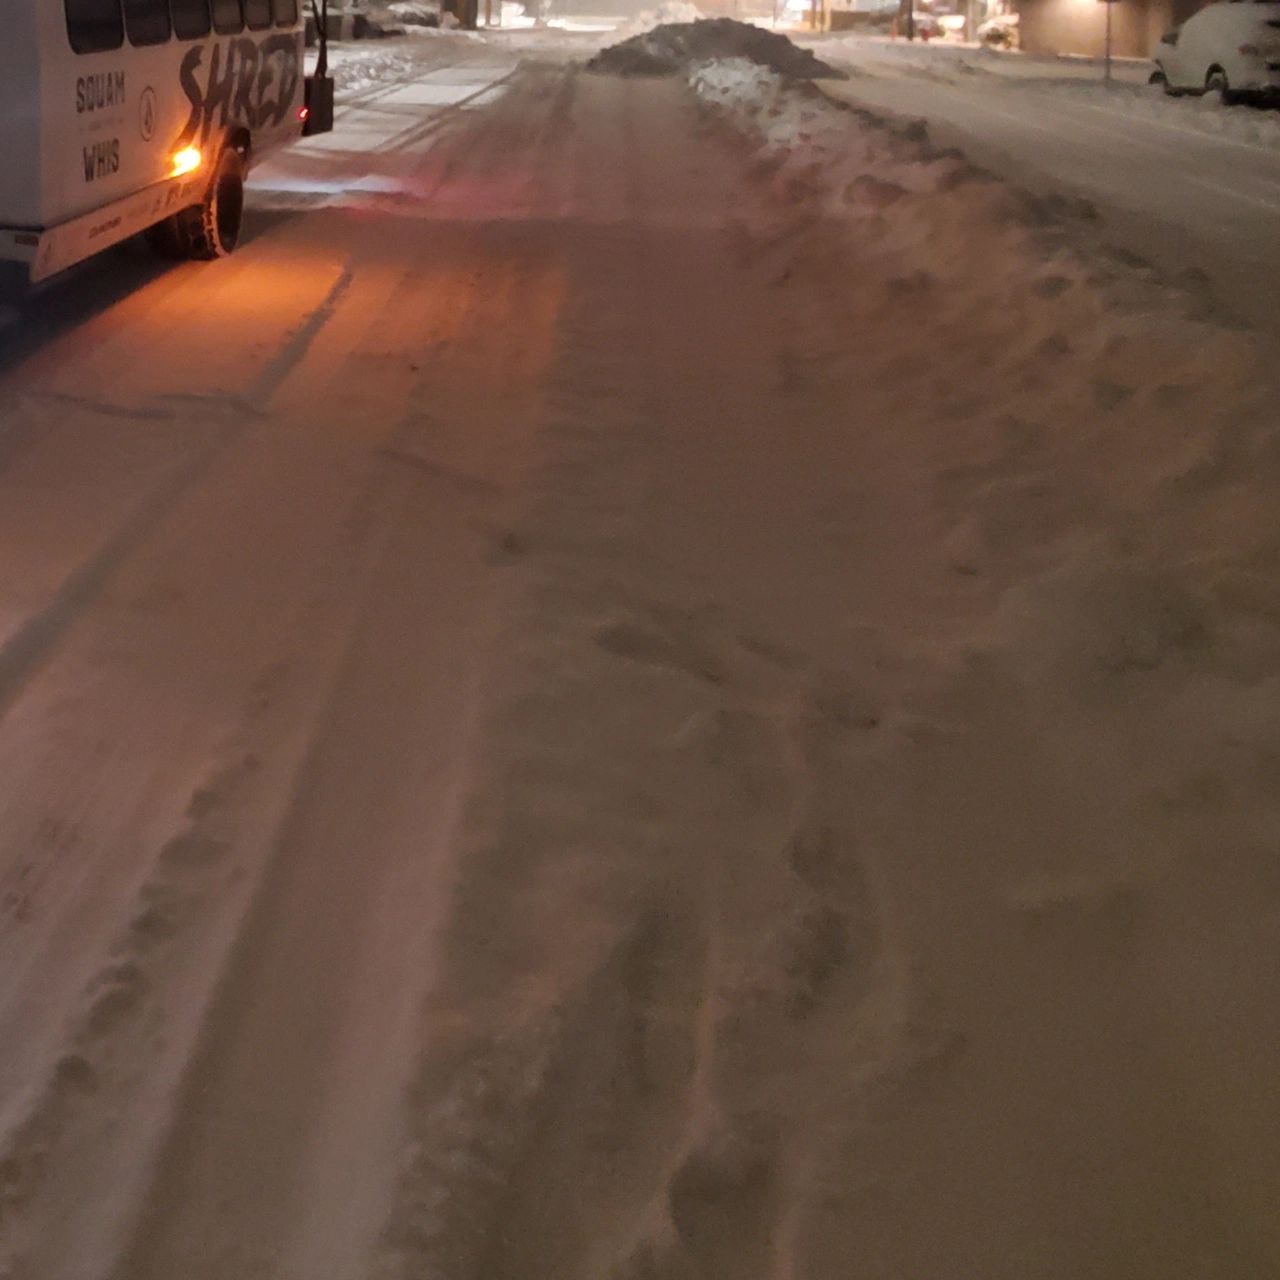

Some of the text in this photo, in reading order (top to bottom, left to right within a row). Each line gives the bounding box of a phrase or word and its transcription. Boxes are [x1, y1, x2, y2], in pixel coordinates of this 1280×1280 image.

[76, 70, 125, 114] SQUAM
[172, 32, 299, 148] SHRED
[83, 138, 119, 182] WHIS
